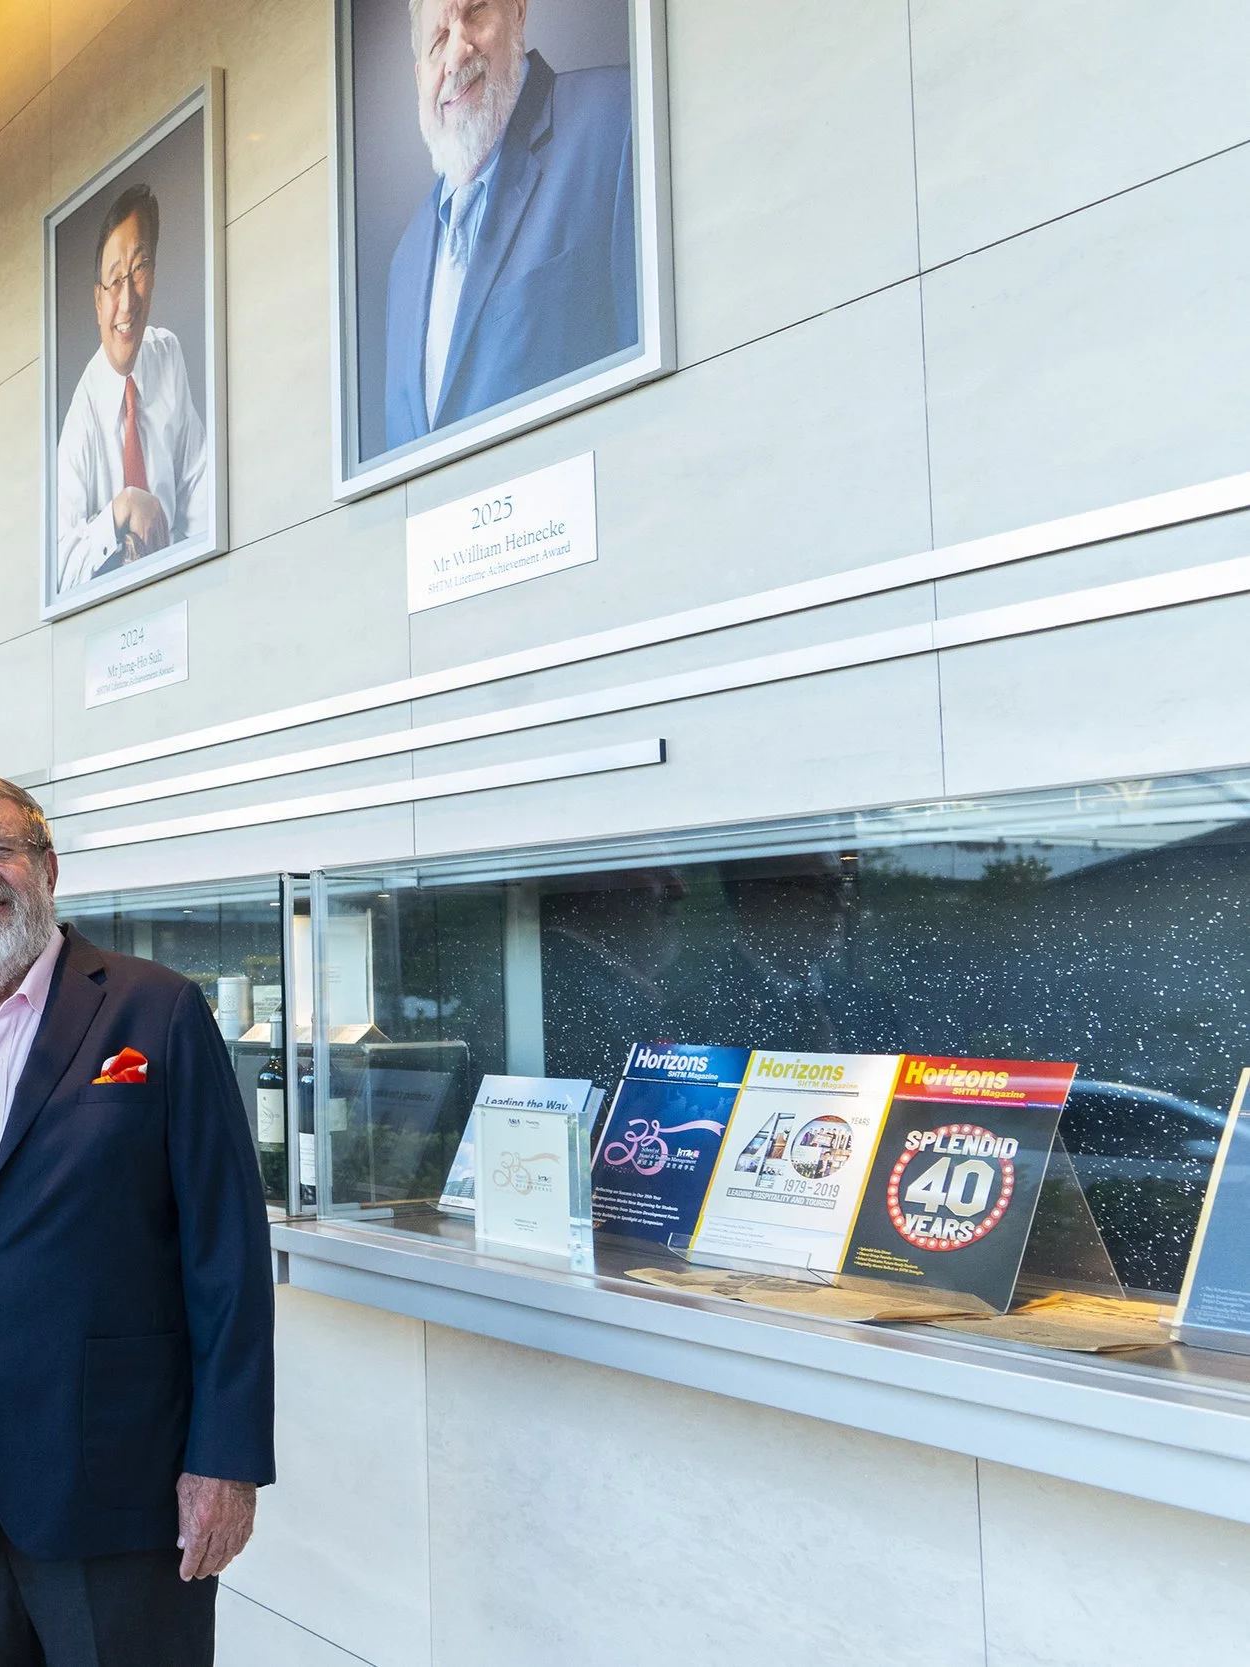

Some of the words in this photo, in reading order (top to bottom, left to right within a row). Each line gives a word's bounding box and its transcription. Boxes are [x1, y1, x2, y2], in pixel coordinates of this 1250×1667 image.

[471, 495, 513, 530] 2025
[433, 558, 451, 576] Mr
[453, 543, 501, 568] William
[506, 520, 565, 552] Heinecke
[454, 568, 486, 588] Lifetime
[488, 553, 540, 576] Achievement
[541, 541, 571, 561] Award
[120, 627, 145, 650] 2024
[634, 1048, 708, 1072] Horizons
[757, 1057, 845, 1081] Horizons
[667, 1070, 687, 1078] SHTM
[688, 1071, 718, 1080] Magazine
[797, 1080, 819, 1089] SHTM
[821, 1082, 858, 1090] Magazine
[904, 1061, 1010, 1089] Horizons
[952, 1087, 979, 1096] SHTM
[981, 1089, 1026, 1099] Magazine
[851, 1117, 870, 1126] YEARS
[905, 1130, 1019, 1159] SPLENDID
[904, 1156, 996, 1218] 40
[753, 1191, 790, 1204] HOSPITALITY
[806, 1198, 835, 1209] TOURISM
[905, 1213, 976, 1242] YEARS
